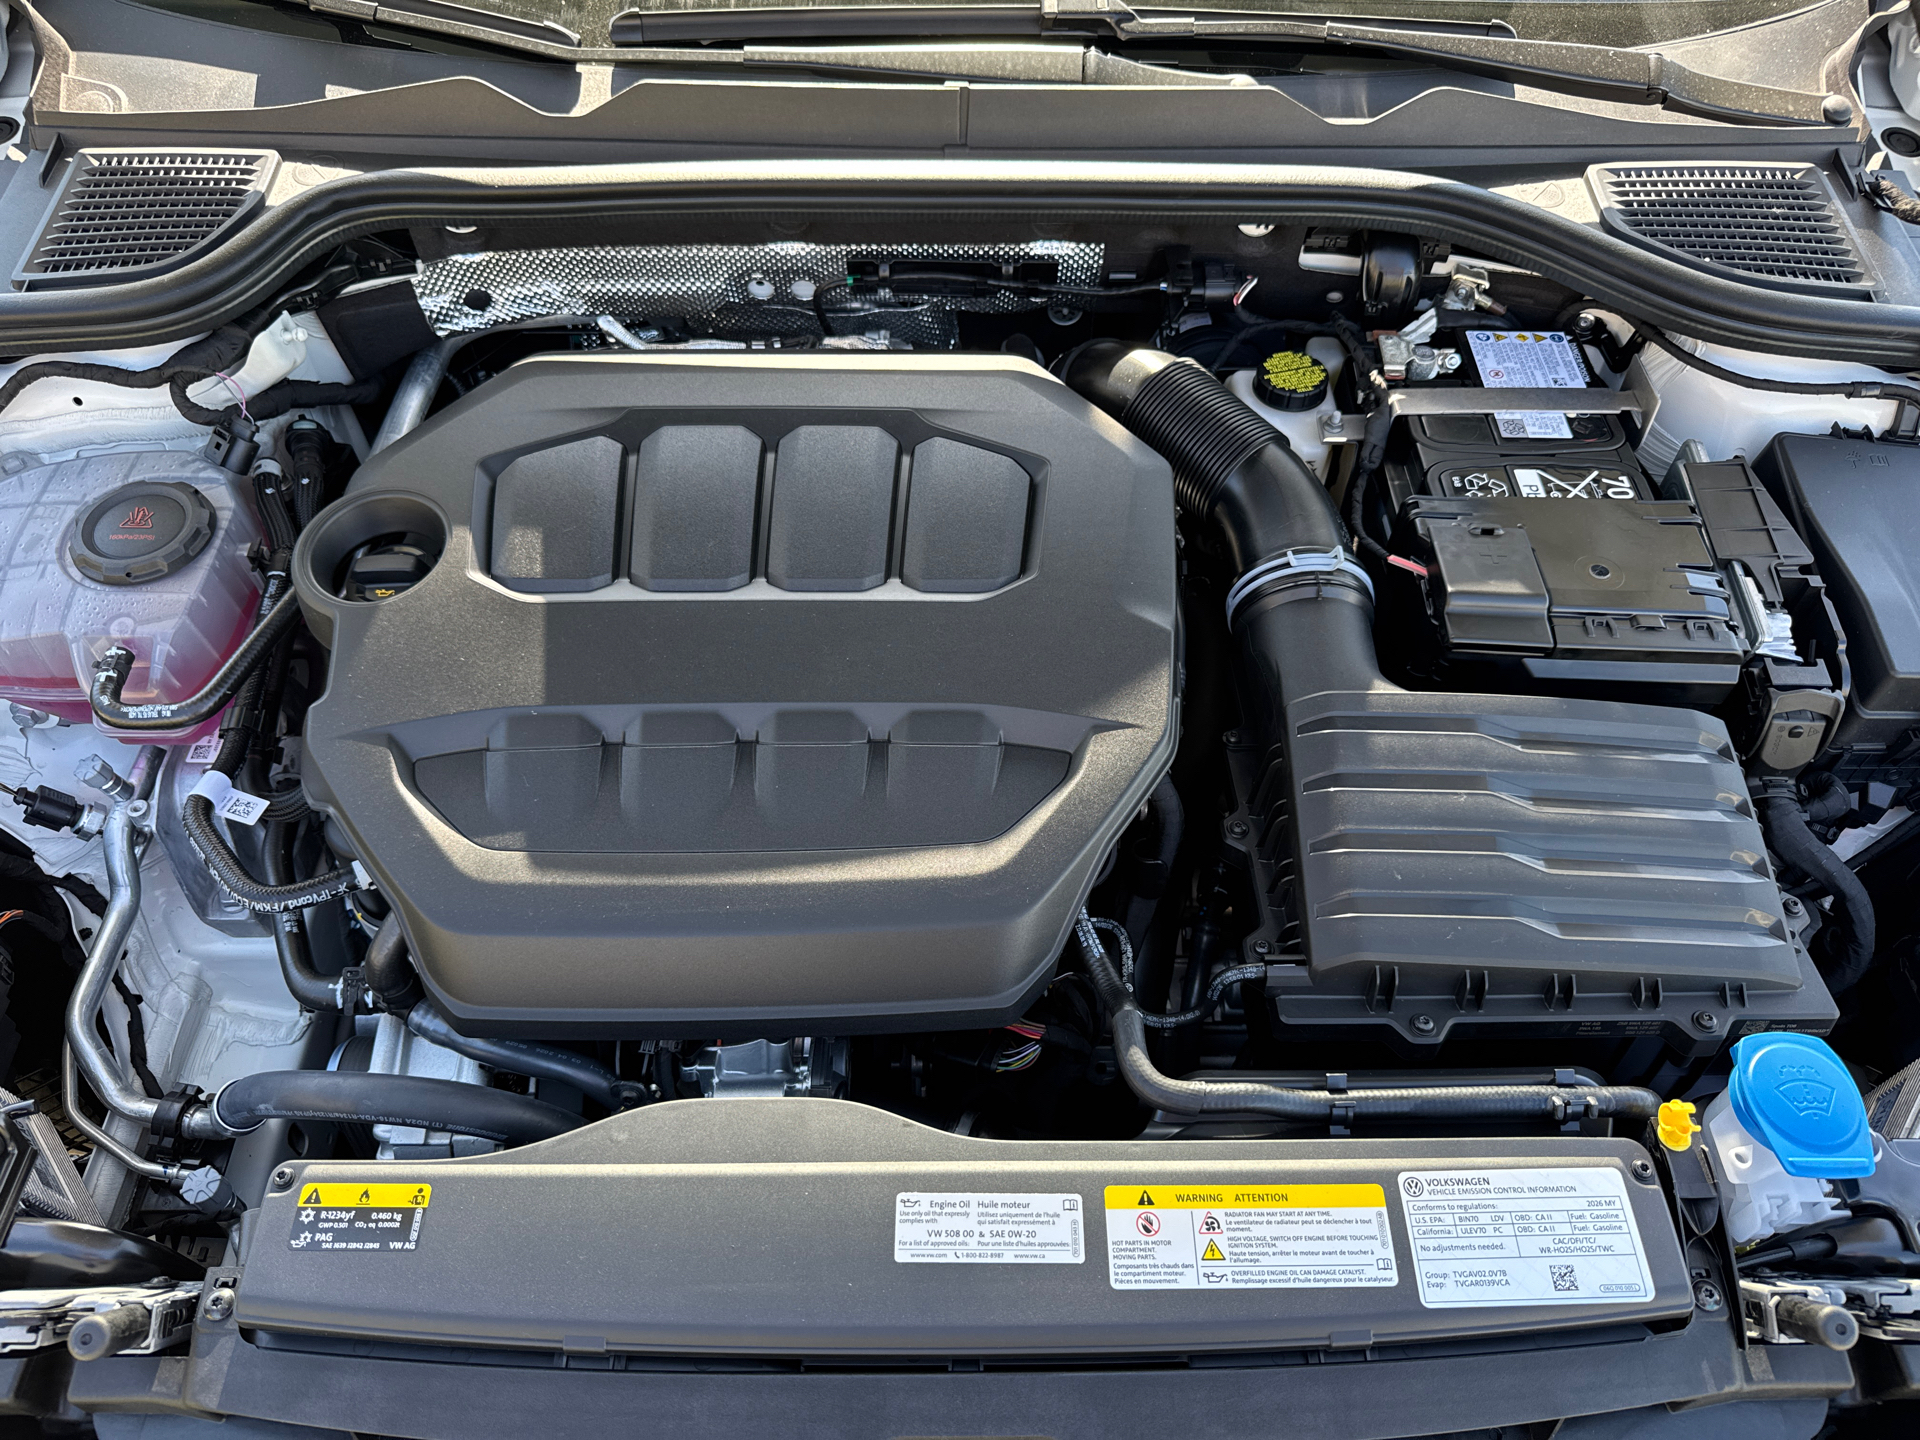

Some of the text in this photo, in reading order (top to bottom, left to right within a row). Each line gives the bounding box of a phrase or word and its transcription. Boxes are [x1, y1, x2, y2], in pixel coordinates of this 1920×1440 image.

[1425, 1178, 1490, 1186] VOLKSWAGEN
[1175, 1194, 1288, 1202] WARNING ATTENTION
[930, 1201, 957, 1210] Engine
[1457, 1203, 1498, 1212] regulations:
[320, 1210, 356, 1220] R-1234yf
[393, 1212, 402, 1221] kg
[315, 1233, 333, 1241] PAG
[1432, 1244, 1476, 1253] adjustments
[1425, 1270, 1507, 1280] Group: TVGAV02.0V7B
[1427, 1279, 1510, 1289] Evap: TVGAR0139VCA
